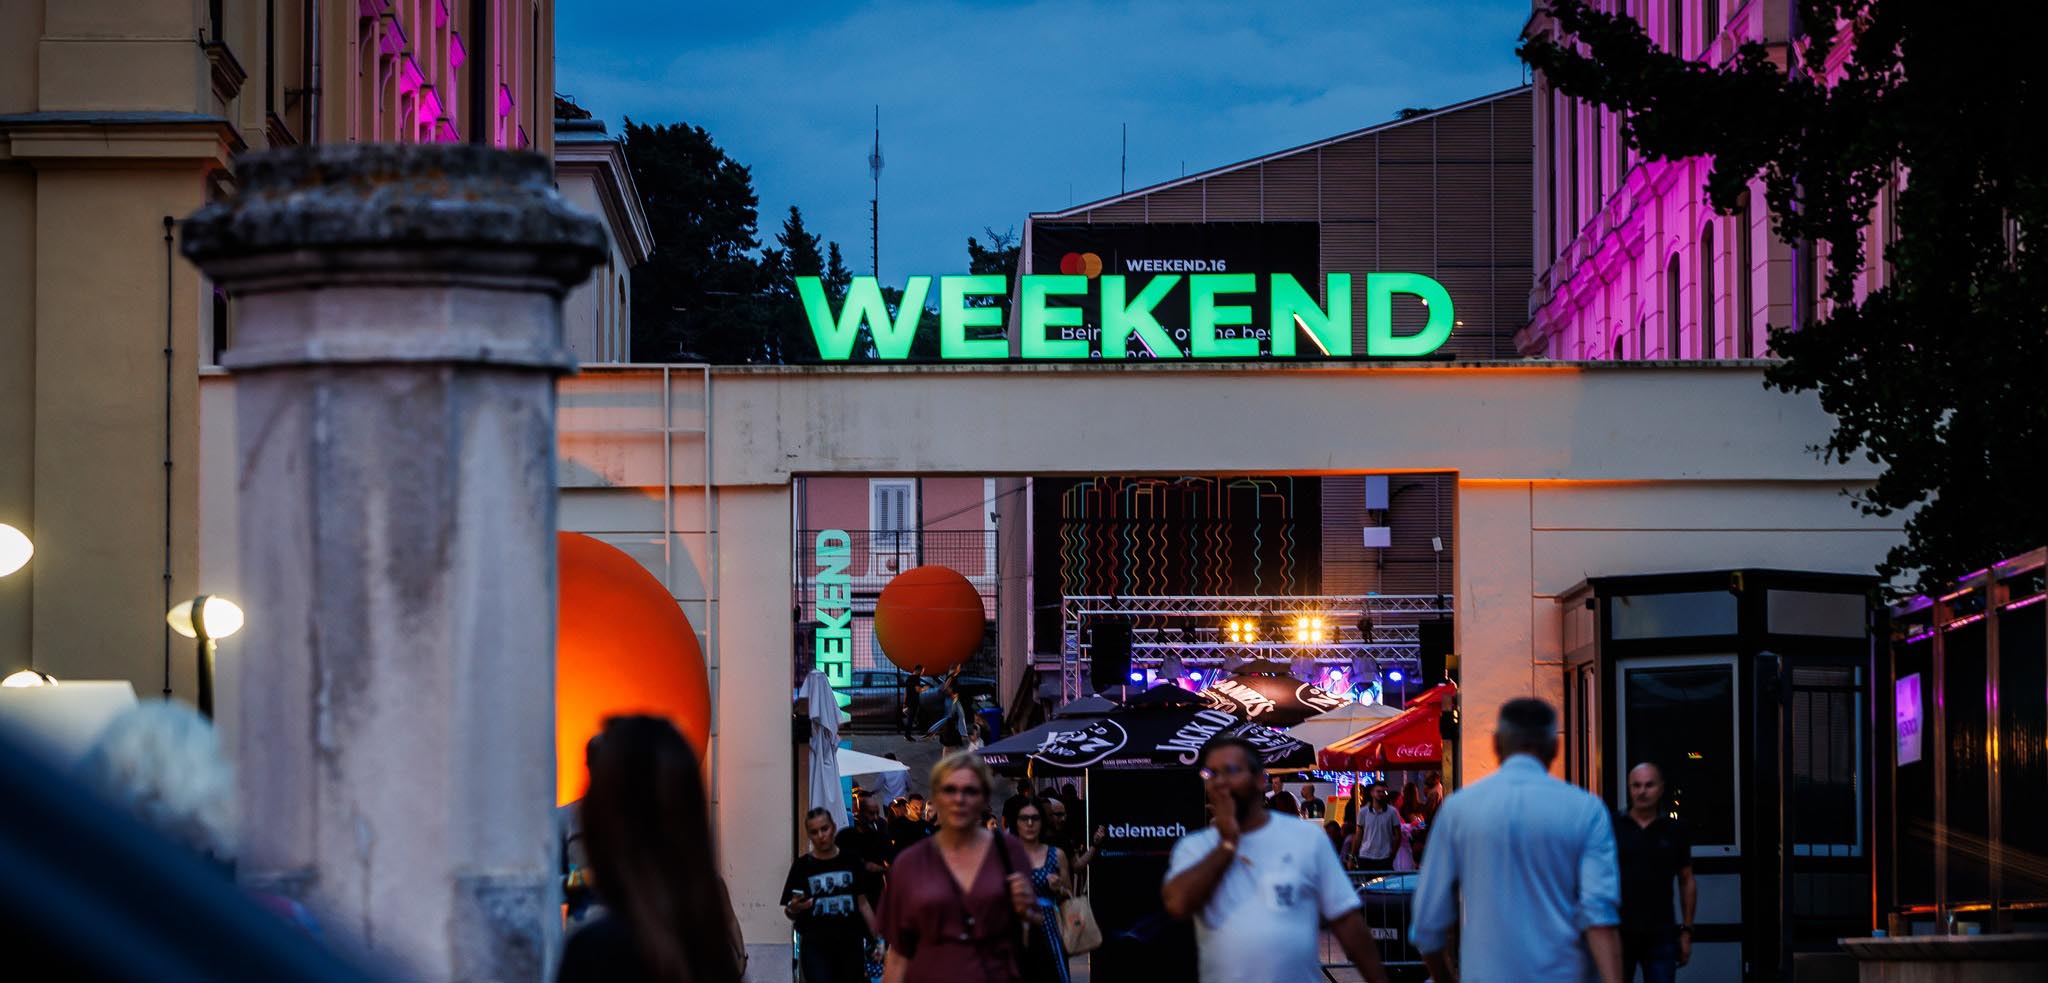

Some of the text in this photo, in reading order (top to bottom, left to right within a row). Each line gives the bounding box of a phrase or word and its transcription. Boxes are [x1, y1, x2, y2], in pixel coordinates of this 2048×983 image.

[1126, 259, 1226, 272] WEEKEND.16
[795, 272, 1455, 360] WEEKEND
[1155, 720, 1223, 766] JACK
[1108, 822, 1187, 838] telemach
